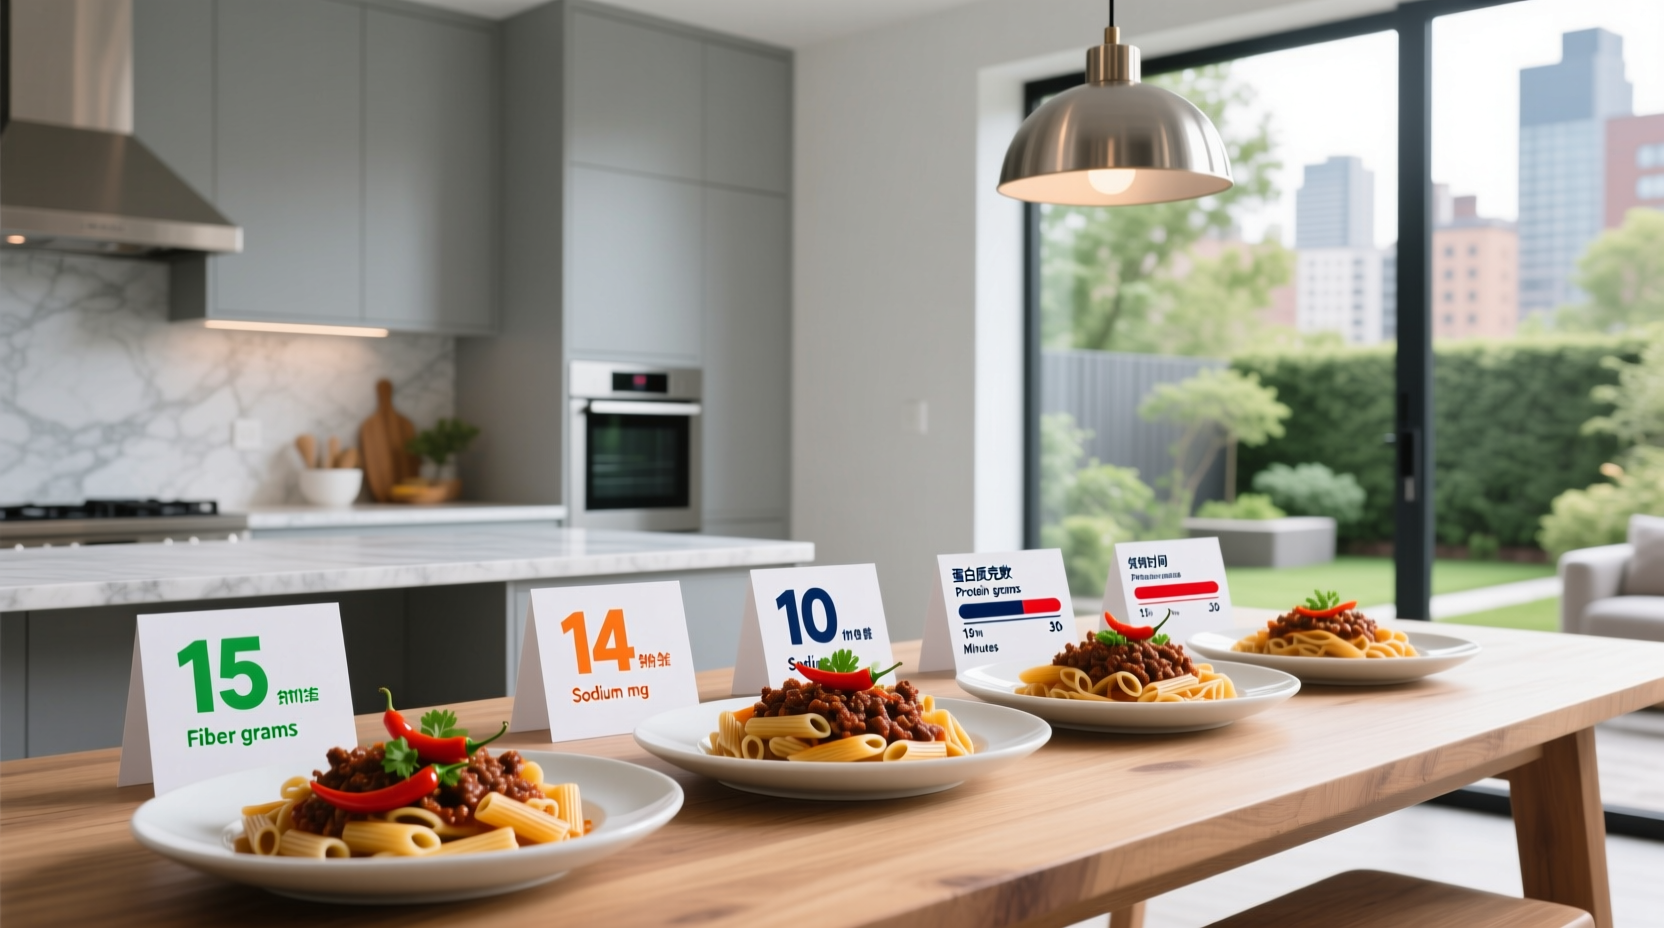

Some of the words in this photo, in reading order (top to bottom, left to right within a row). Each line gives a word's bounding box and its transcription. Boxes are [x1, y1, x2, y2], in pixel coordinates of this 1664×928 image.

[776, 587, 838, 645] 10
[1049, 621, 1063, 632] 30
[561, 609, 635, 674] 14
[177, 636, 268, 713] 15
[572, 685, 623, 703] Sodium
[628, 685, 649, 699] mg
[187, 728, 236, 747] Fiber
[241, 723, 298, 746] grams
